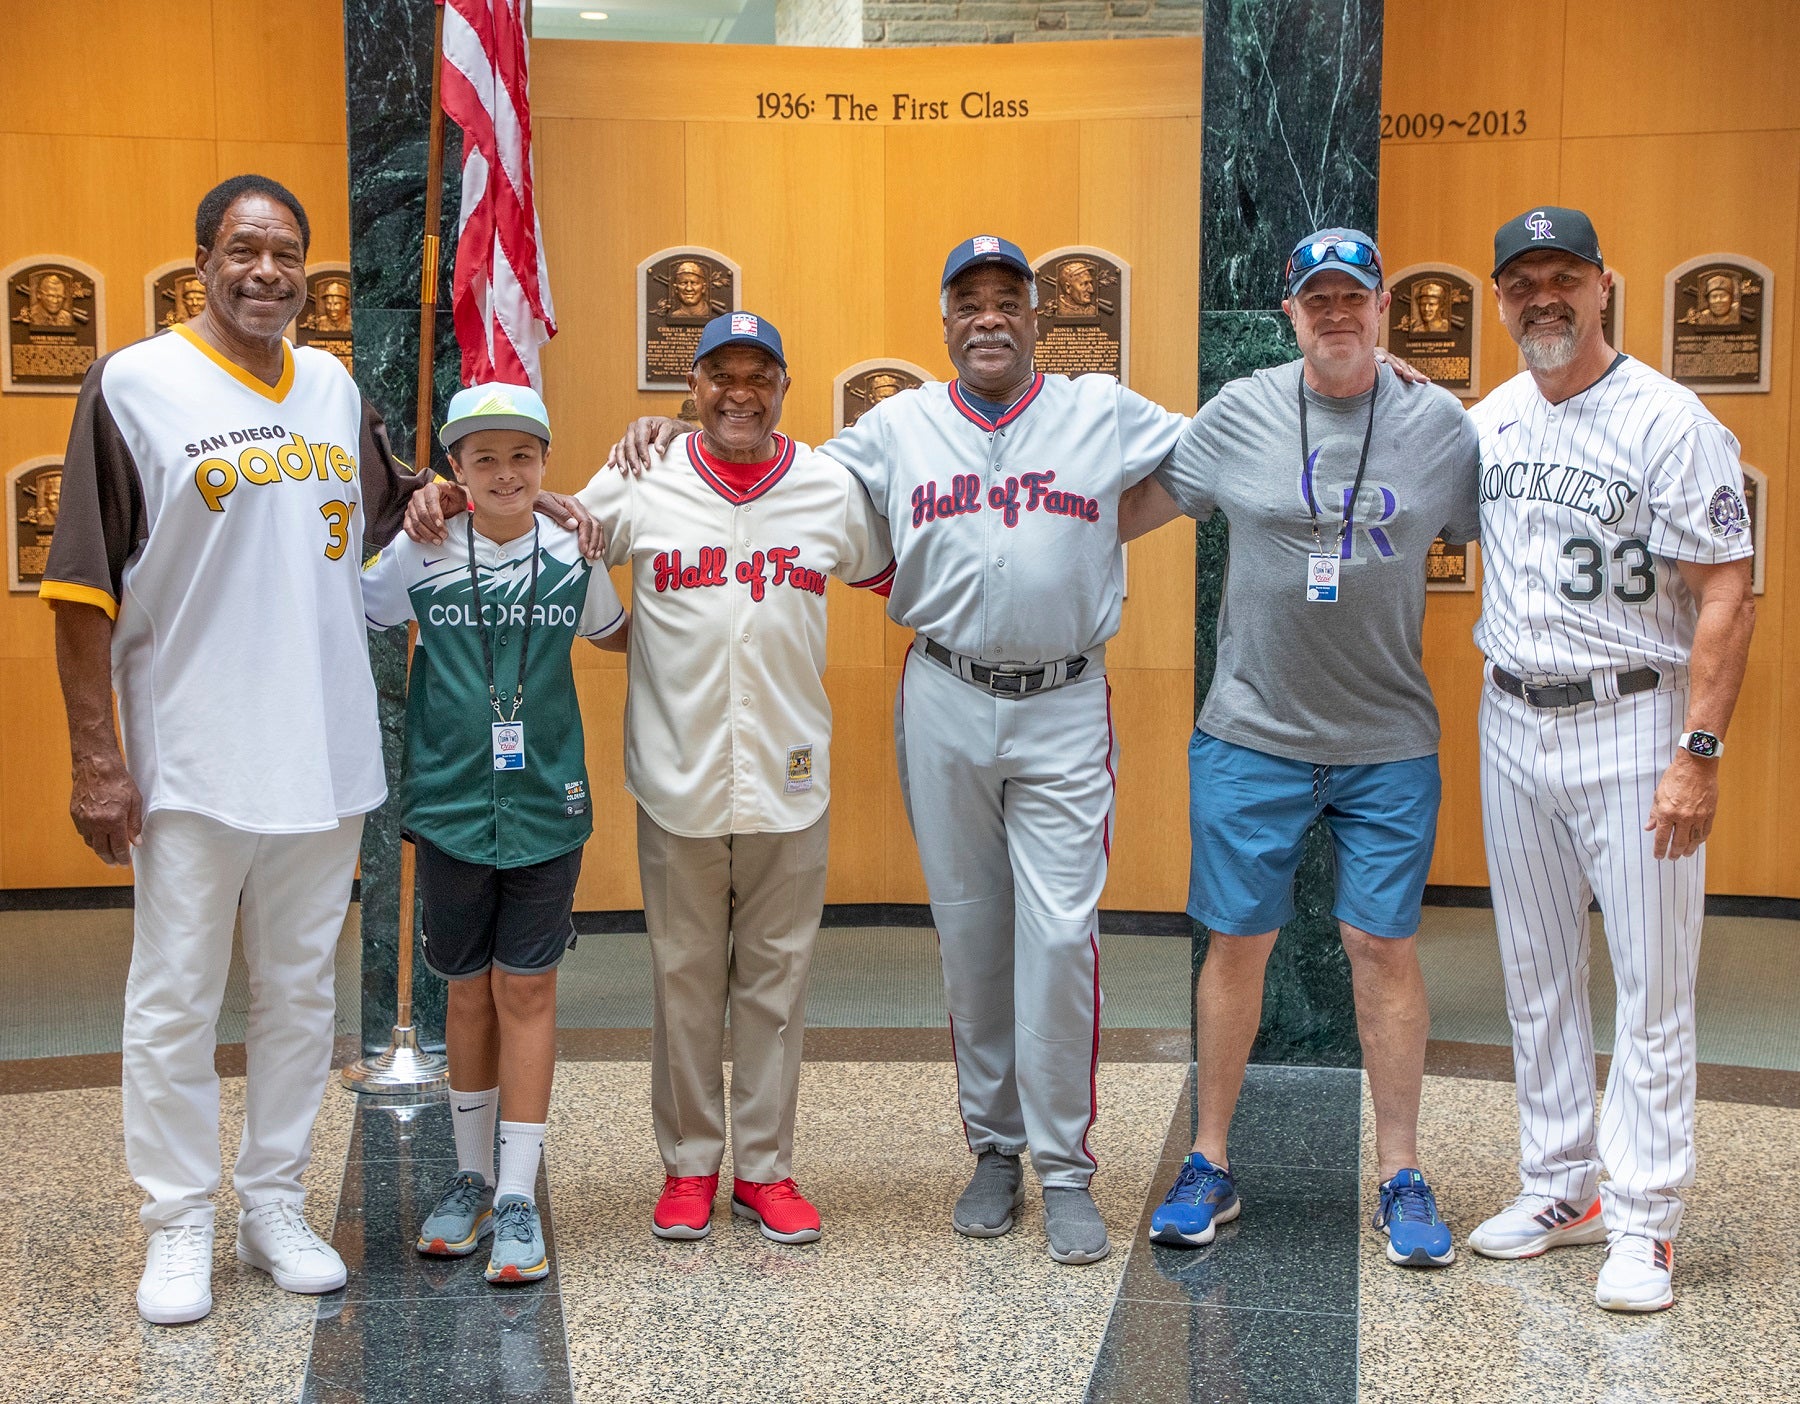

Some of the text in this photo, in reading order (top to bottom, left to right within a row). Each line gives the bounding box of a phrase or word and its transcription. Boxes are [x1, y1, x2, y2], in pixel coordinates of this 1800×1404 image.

[756, 91, 1029, 121] 1936: The First Class
[185, 424, 286, 458] SAN DIEGO
[911, 469, 1100, 529] Hall of Fame
[318, 499, 357, 561] 3
[653, 545, 728, 592] Hall
[736, 550, 767, 602] of
[1558, 535, 1658, 605] 33
[428, 604, 577, 627] COLORADO
